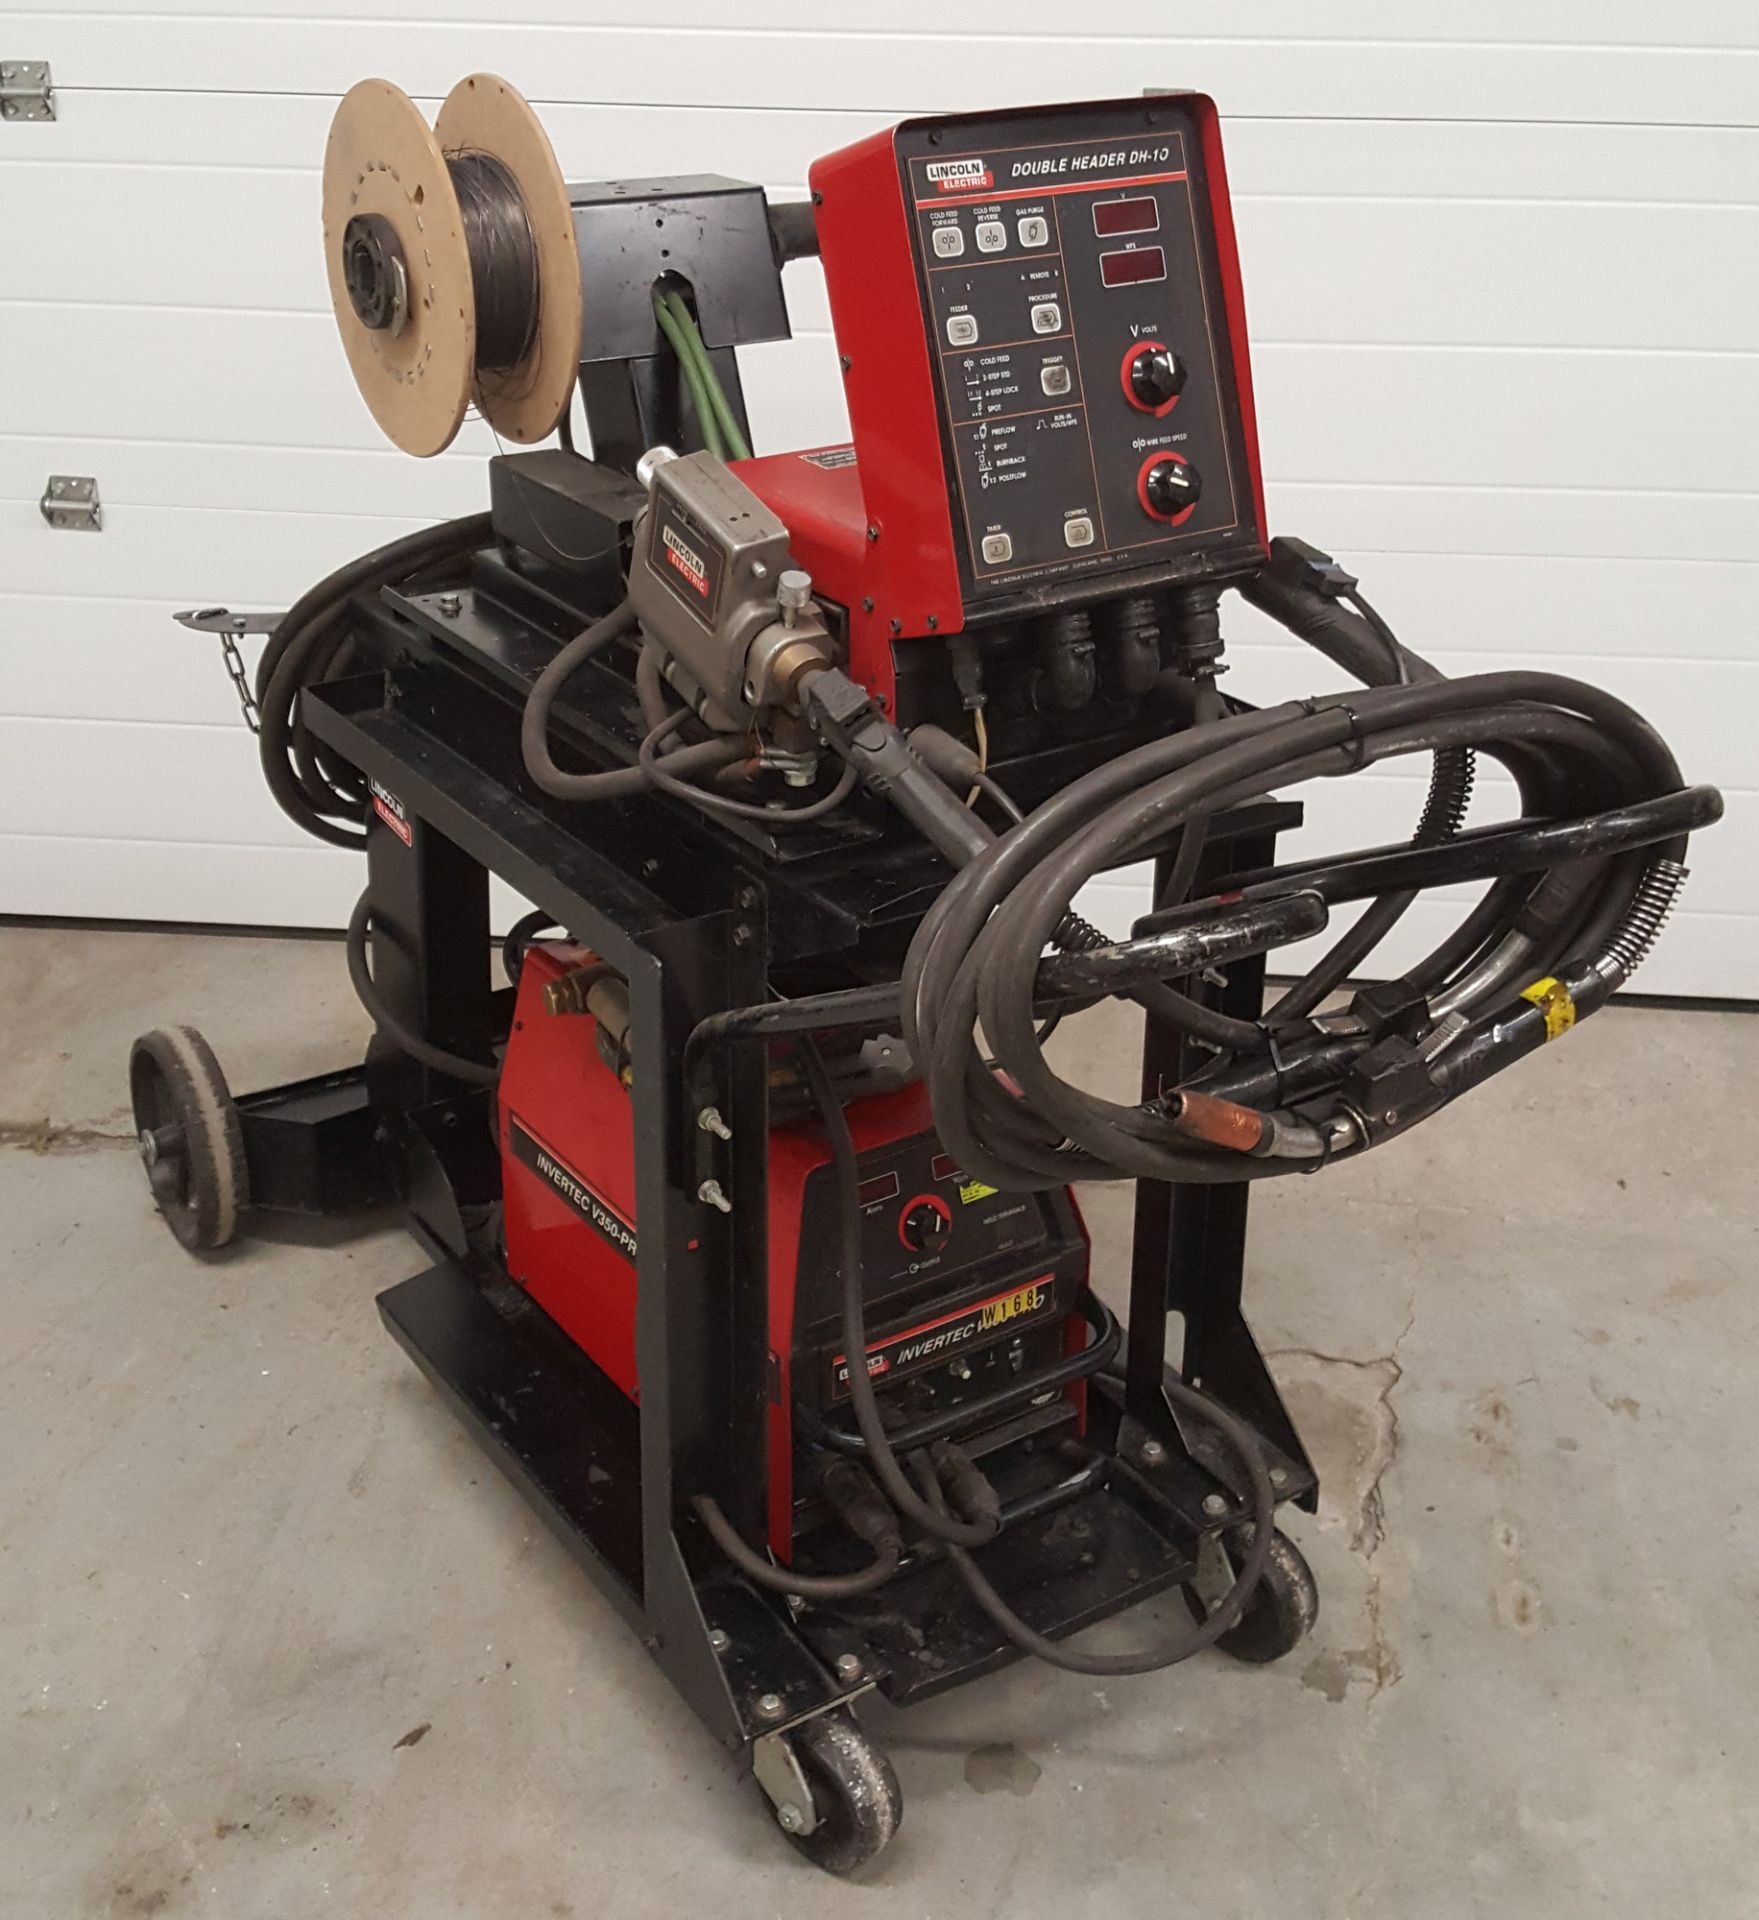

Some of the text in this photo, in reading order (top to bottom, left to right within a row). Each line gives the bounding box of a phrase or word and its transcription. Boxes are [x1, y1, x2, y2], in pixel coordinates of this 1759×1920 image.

[1011, 148, 1169, 177] DOUBLE HEADER DH-10
[930, 162, 980, 178] LINCOLN
[943, 177, 987, 189] ELECTRIC
[930, 210, 958, 220] COLD FEED
[973, 205, 1001, 215] COLD FEED
[1028, 206, 1044, 214] PURGE
[932, 218, 958, 226] FORWARD
[977, 213, 999, 221] REVERSE
[1030, 271, 1050, 280] REMOTE
[1028, 293, 1058, 302] PROCEDURE
[950, 304, 968, 312] FEEDER
[1129, 323, 1158, 337] V VOLTS
[980, 355, 1010, 366] COLD FEED
[1042, 355, 1064, 364] TRIGGER
[982, 371, 1010, 381] 2-STEP STD
[985, 385, 1019, 397] 4-STEP LOCK
[987, 403, 1001, 413] SPOT
[1054, 413, 1072, 421] RUN-IN
[991, 425, 1016, 435] PREFLOW
[1146, 432, 1187, 446] WIRE FEED SPEED
[993, 443, 1008, 451] SPOT
[996, 456, 1026, 467] BURNBACK
[998, 471, 1027, 482] POSTFLOW
[1064, 508, 1088, 518] CONTROL
[665, 529, 702, 574] LINCOLN
[671, 553, 705, 593] ELECTRIC
[536, 1153, 590, 1211] INVERTEC
[896, 1324, 974, 1364] INVERTEC
